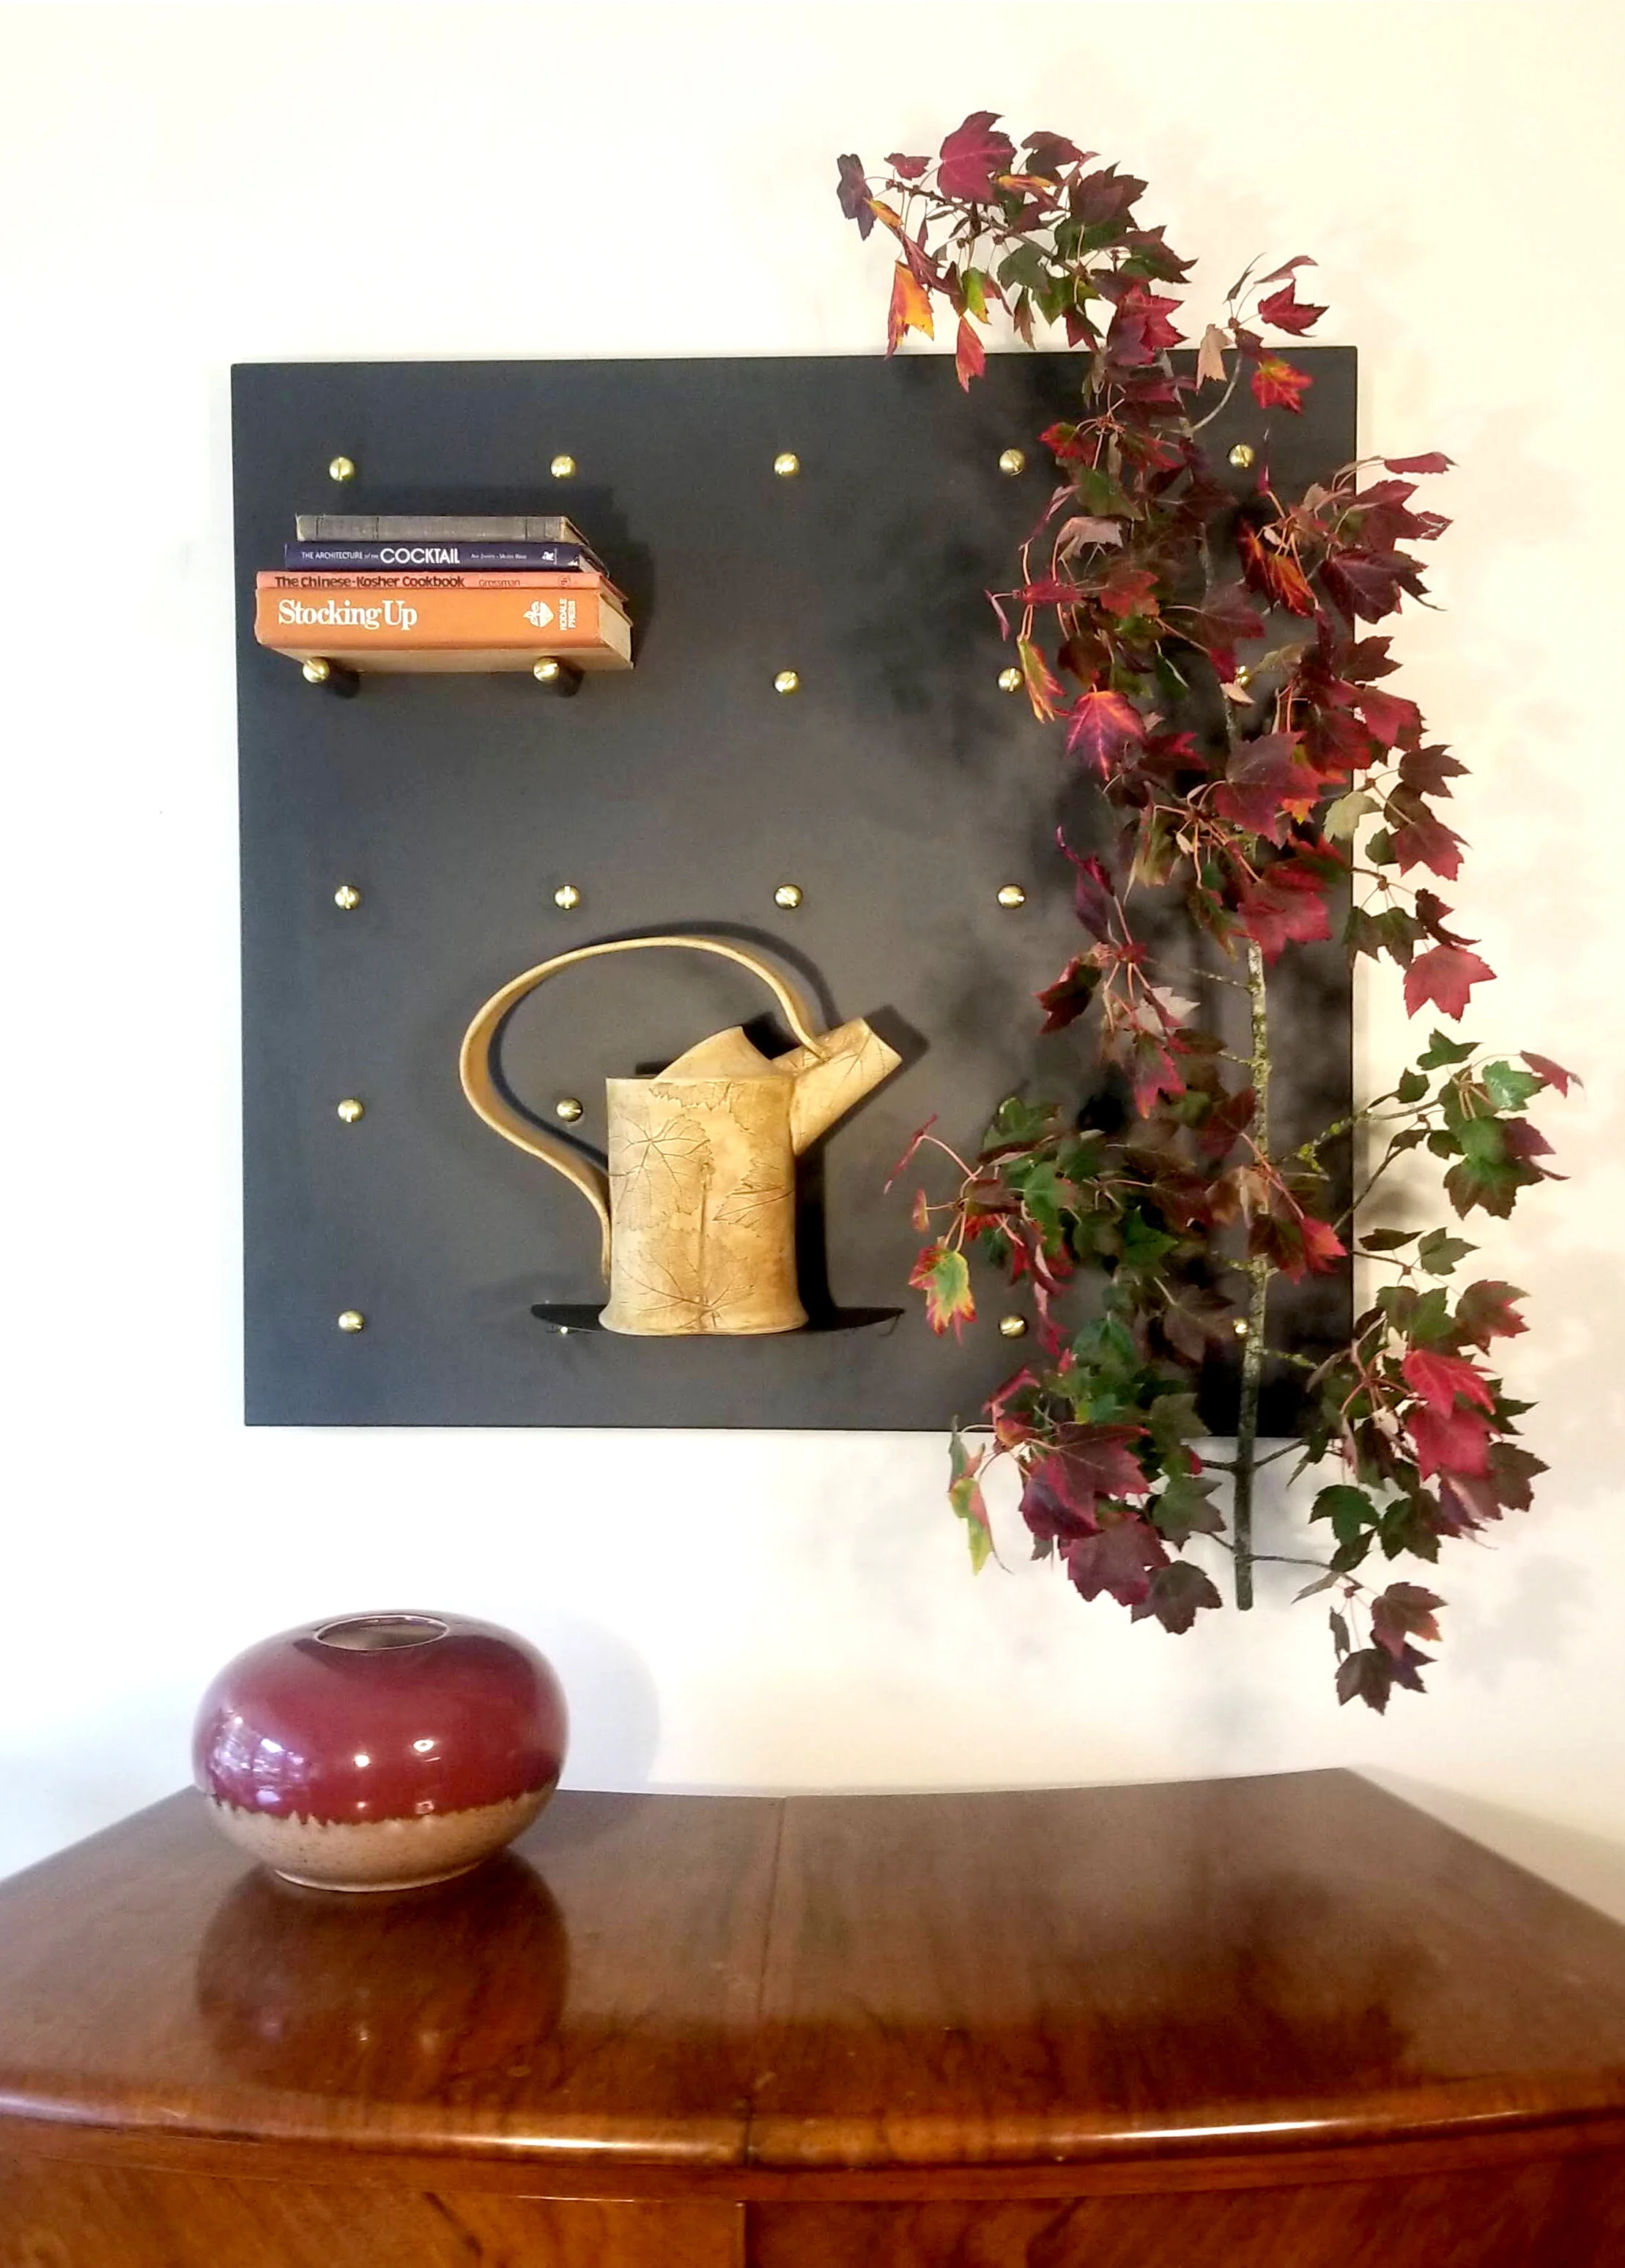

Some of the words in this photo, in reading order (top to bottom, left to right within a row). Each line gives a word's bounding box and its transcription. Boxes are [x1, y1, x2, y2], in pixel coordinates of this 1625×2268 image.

[301, 550, 314, 560] THE
[315, 550, 363, 560] ARCHITECTURE
[380, 547, 460, 564] COCKTAIL
[275, 576, 299, 587] The
[300, 575, 400, 587] Chinese-Kosher
[402, 576, 465, 587] Cookbook
[478, 579, 520, 587] Grossman
[278, 599, 382, 630] Stocking
[382, 599, 418, 631] Up
[559, 598, 568, 631] RODALE
[568, 600, 576, 628] PRESS
